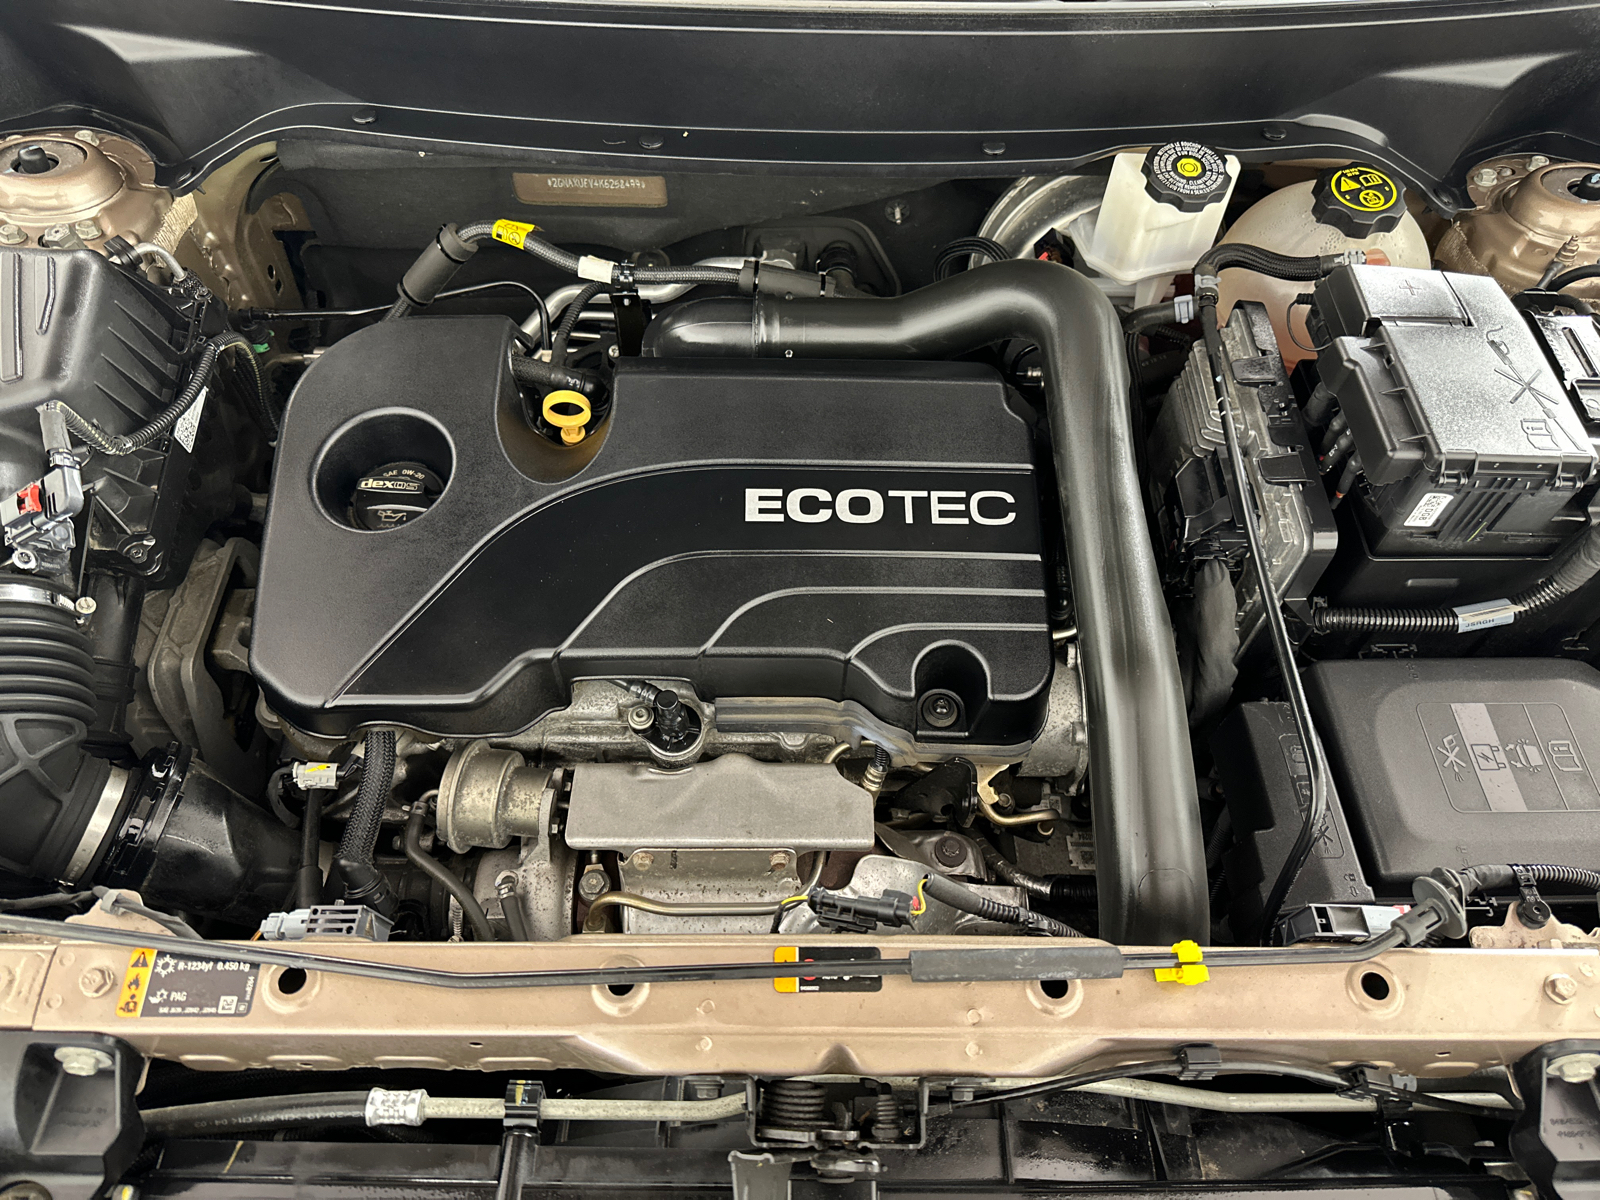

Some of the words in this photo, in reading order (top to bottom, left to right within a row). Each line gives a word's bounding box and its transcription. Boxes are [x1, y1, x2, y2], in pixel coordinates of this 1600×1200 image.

[383, 470, 398, 478] SAE
[361, 479, 420, 491] dexos
[745, 488, 1017, 526] ECOTEC
[239, 962, 251, 973] kg
[170, 991, 188, 1002] PAG
